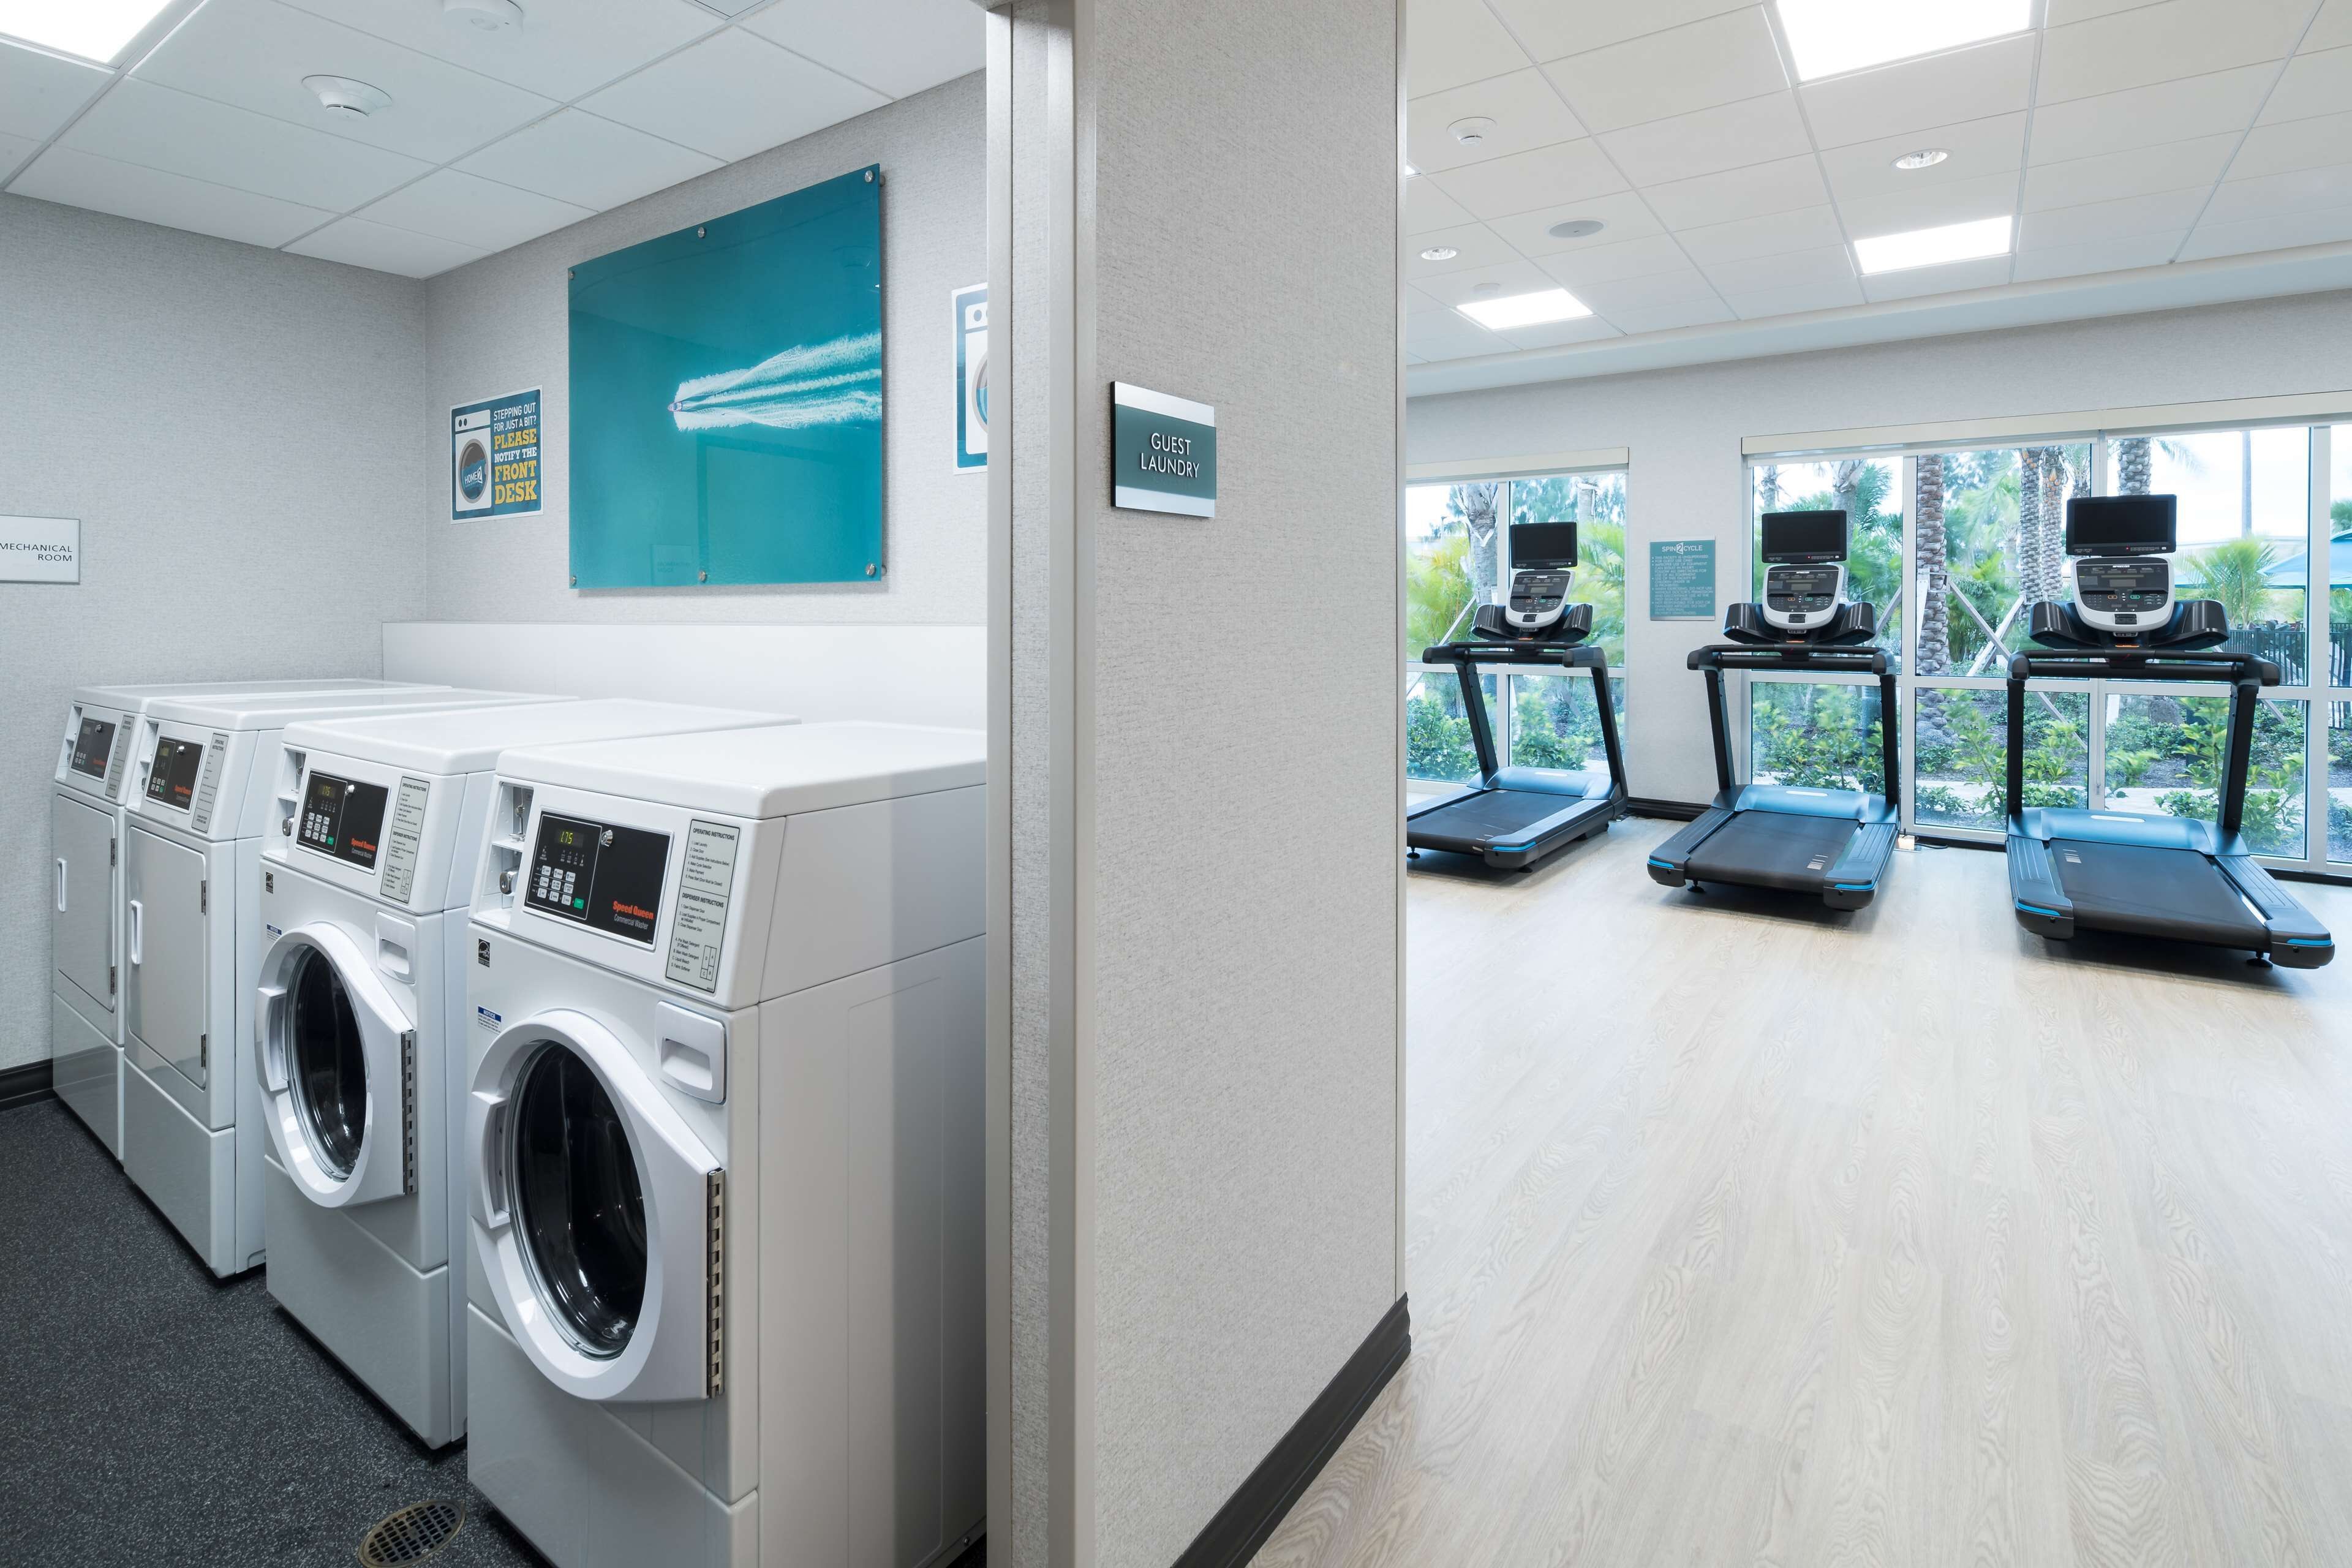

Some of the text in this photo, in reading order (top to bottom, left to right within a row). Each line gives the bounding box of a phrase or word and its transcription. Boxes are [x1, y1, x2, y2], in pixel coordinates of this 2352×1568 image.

[494, 402, 536, 421] STEPPING OUT
[494, 416, 537, 432] FOR JUST A BIT?
[494, 428, 537, 450] PLEASE
[1151, 432, 1191, 456] GUEST
[494, 447, 537, 463] NOTIFY THE
[494, 460, 537, 482] FRONT
[1141, 452, 1199, 478] LAUNDRY
[494, 480, 537, 505] DESK
[0, 543, 73, 552] MECHANICAL
[693, 827, 735, 840] OPERATING INSTRUCTIONS
[682, 892, 724, 908] DISPENSER INSTRUCTIONS
[613, 900, 654, 920] Speed Queen
[614, 913, 649, 930] Commercial Washer
